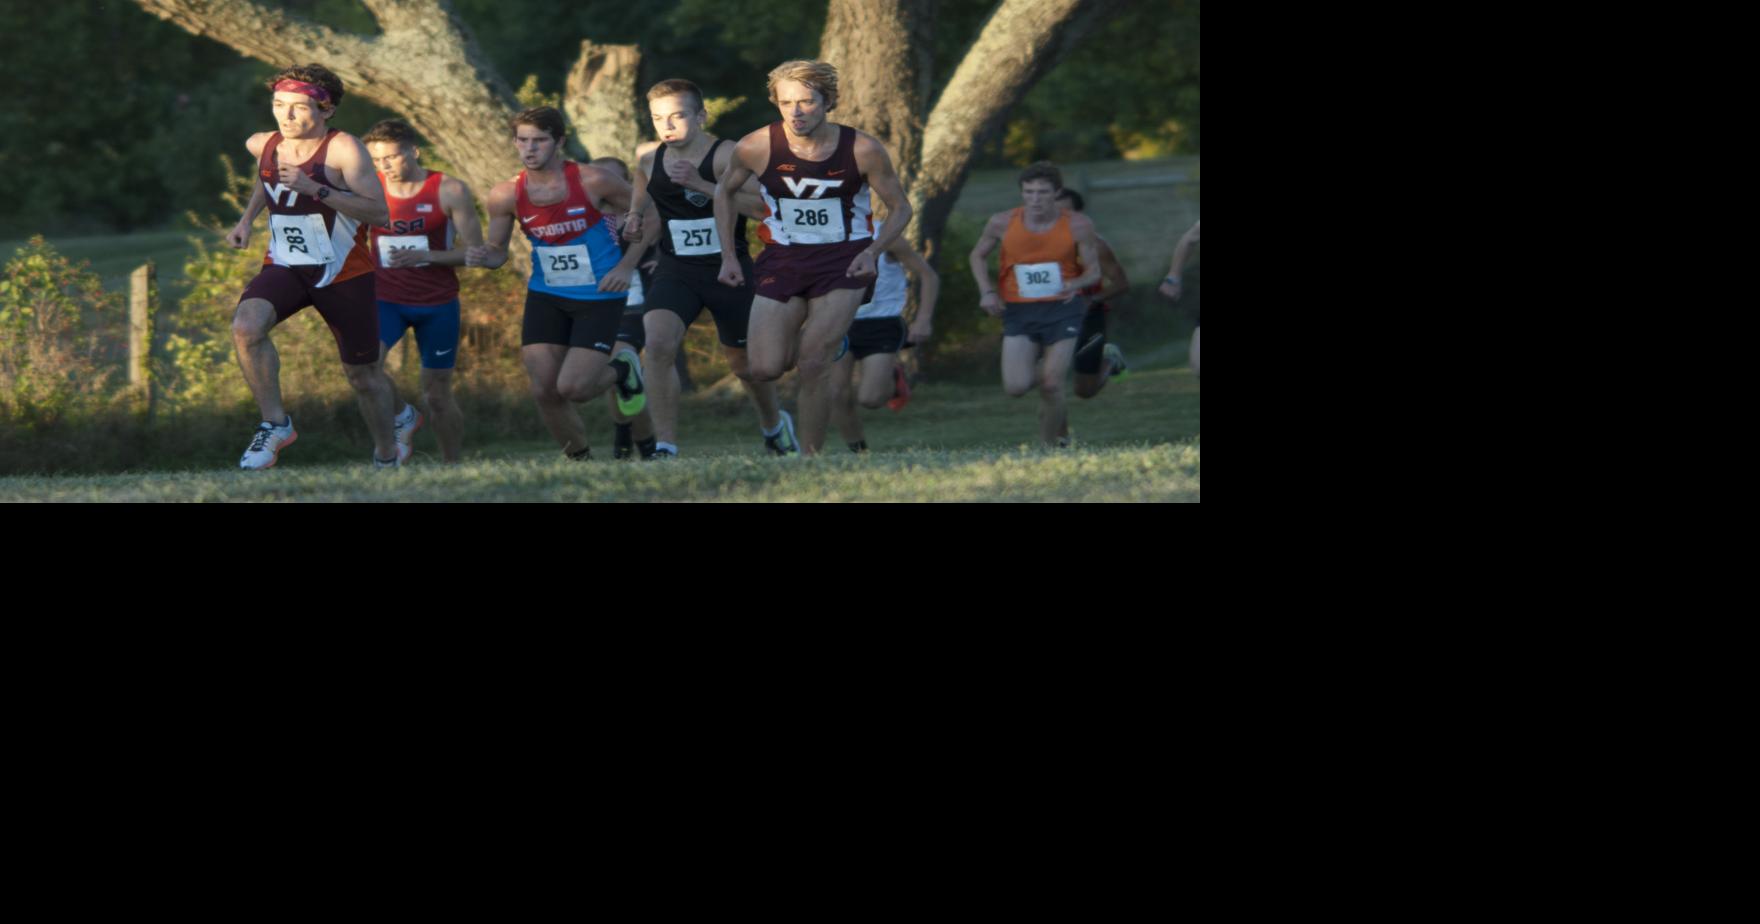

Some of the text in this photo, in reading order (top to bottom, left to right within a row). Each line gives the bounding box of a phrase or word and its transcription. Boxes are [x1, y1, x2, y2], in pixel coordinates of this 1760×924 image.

[781, 176, 845, 199] VT
[383, 217, 424, 235] SA
[793, 208, 829, 226] 286
[283, 226, 309, 254] 283
[681, 228, 712, 247] 257
[548, 254, 579, 271] 255
[1025, 270, 1051, 285] 302
